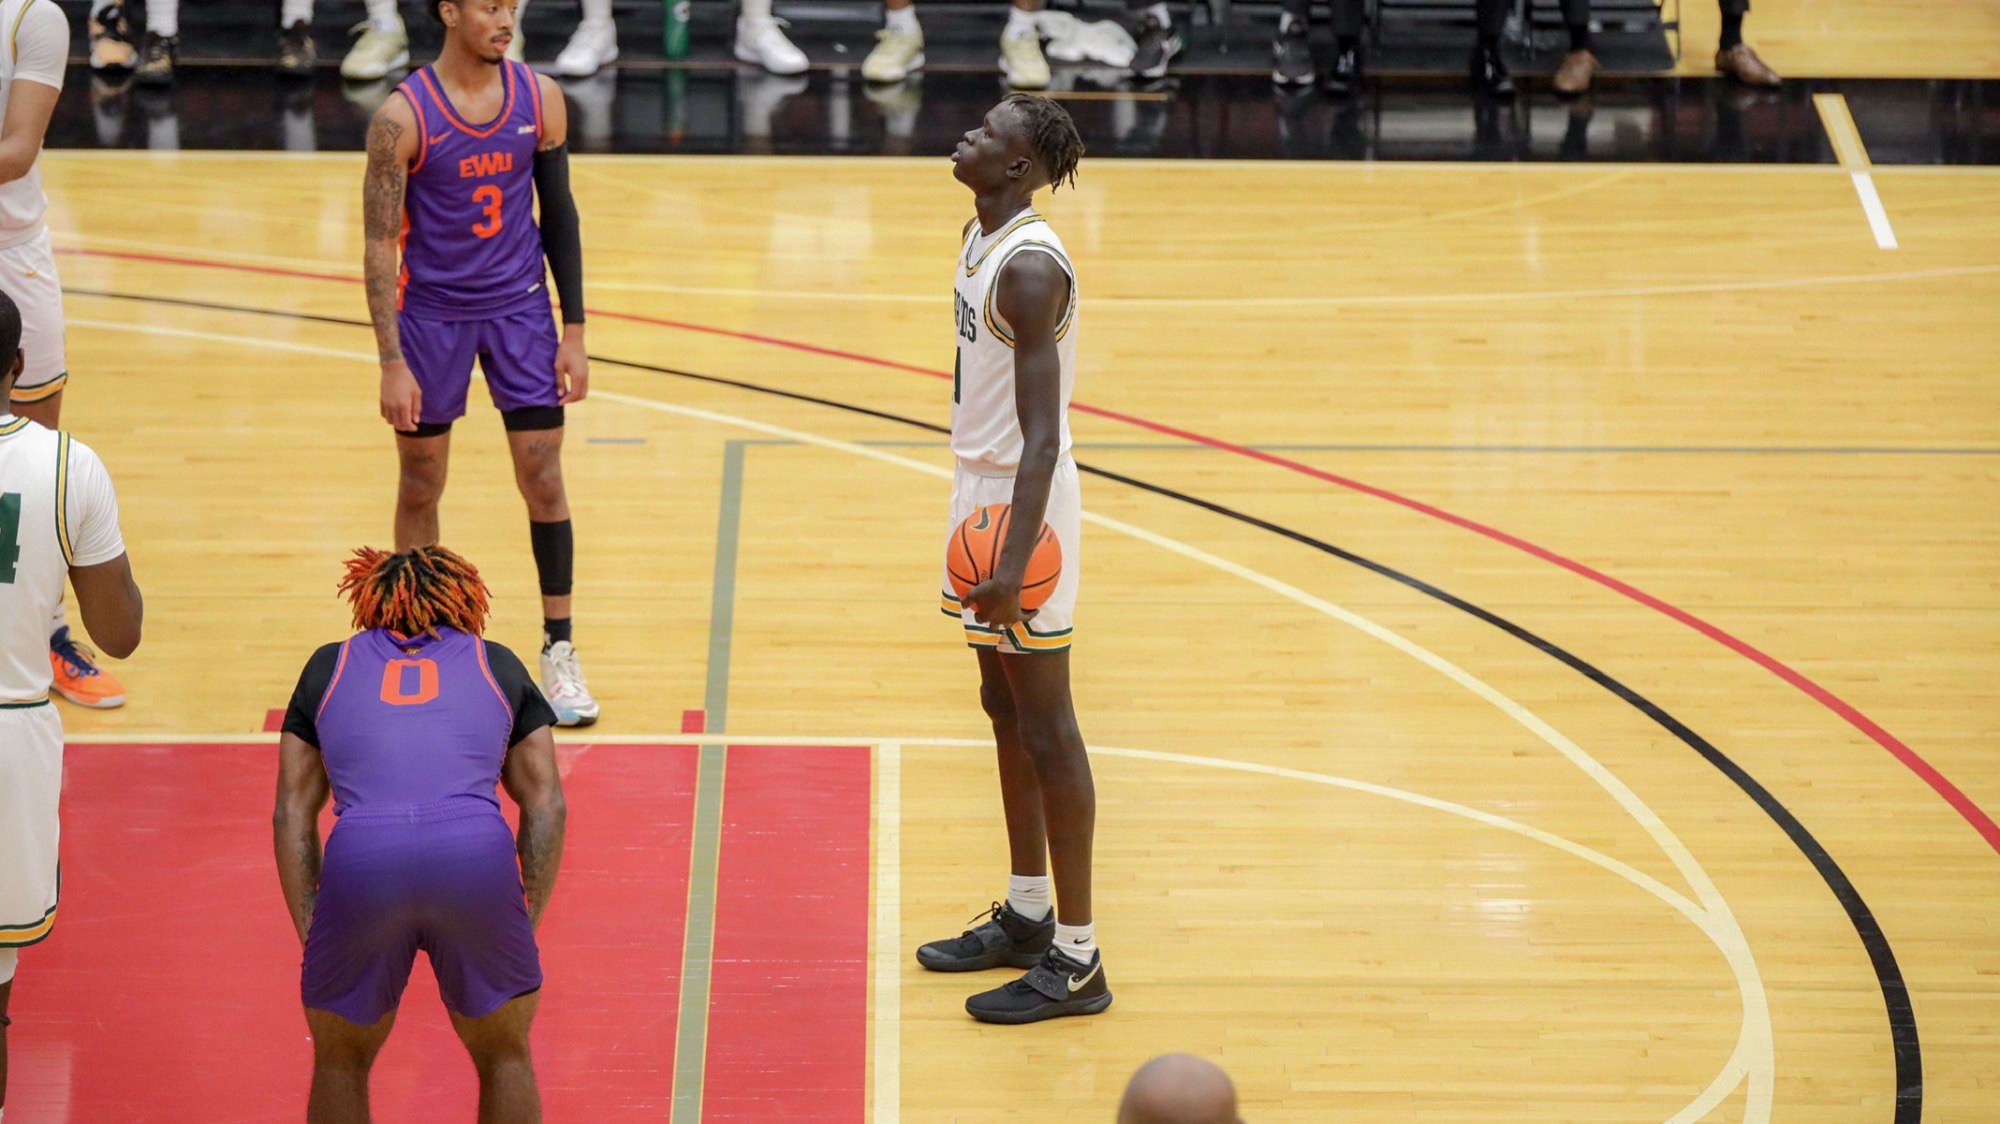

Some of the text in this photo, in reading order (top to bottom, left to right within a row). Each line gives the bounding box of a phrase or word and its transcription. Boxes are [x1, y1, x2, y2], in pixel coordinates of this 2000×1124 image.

[459, 152, 513, 178] EWU
[471, 184, 503, 238] 3
[380, 658, 439, 705] 0
